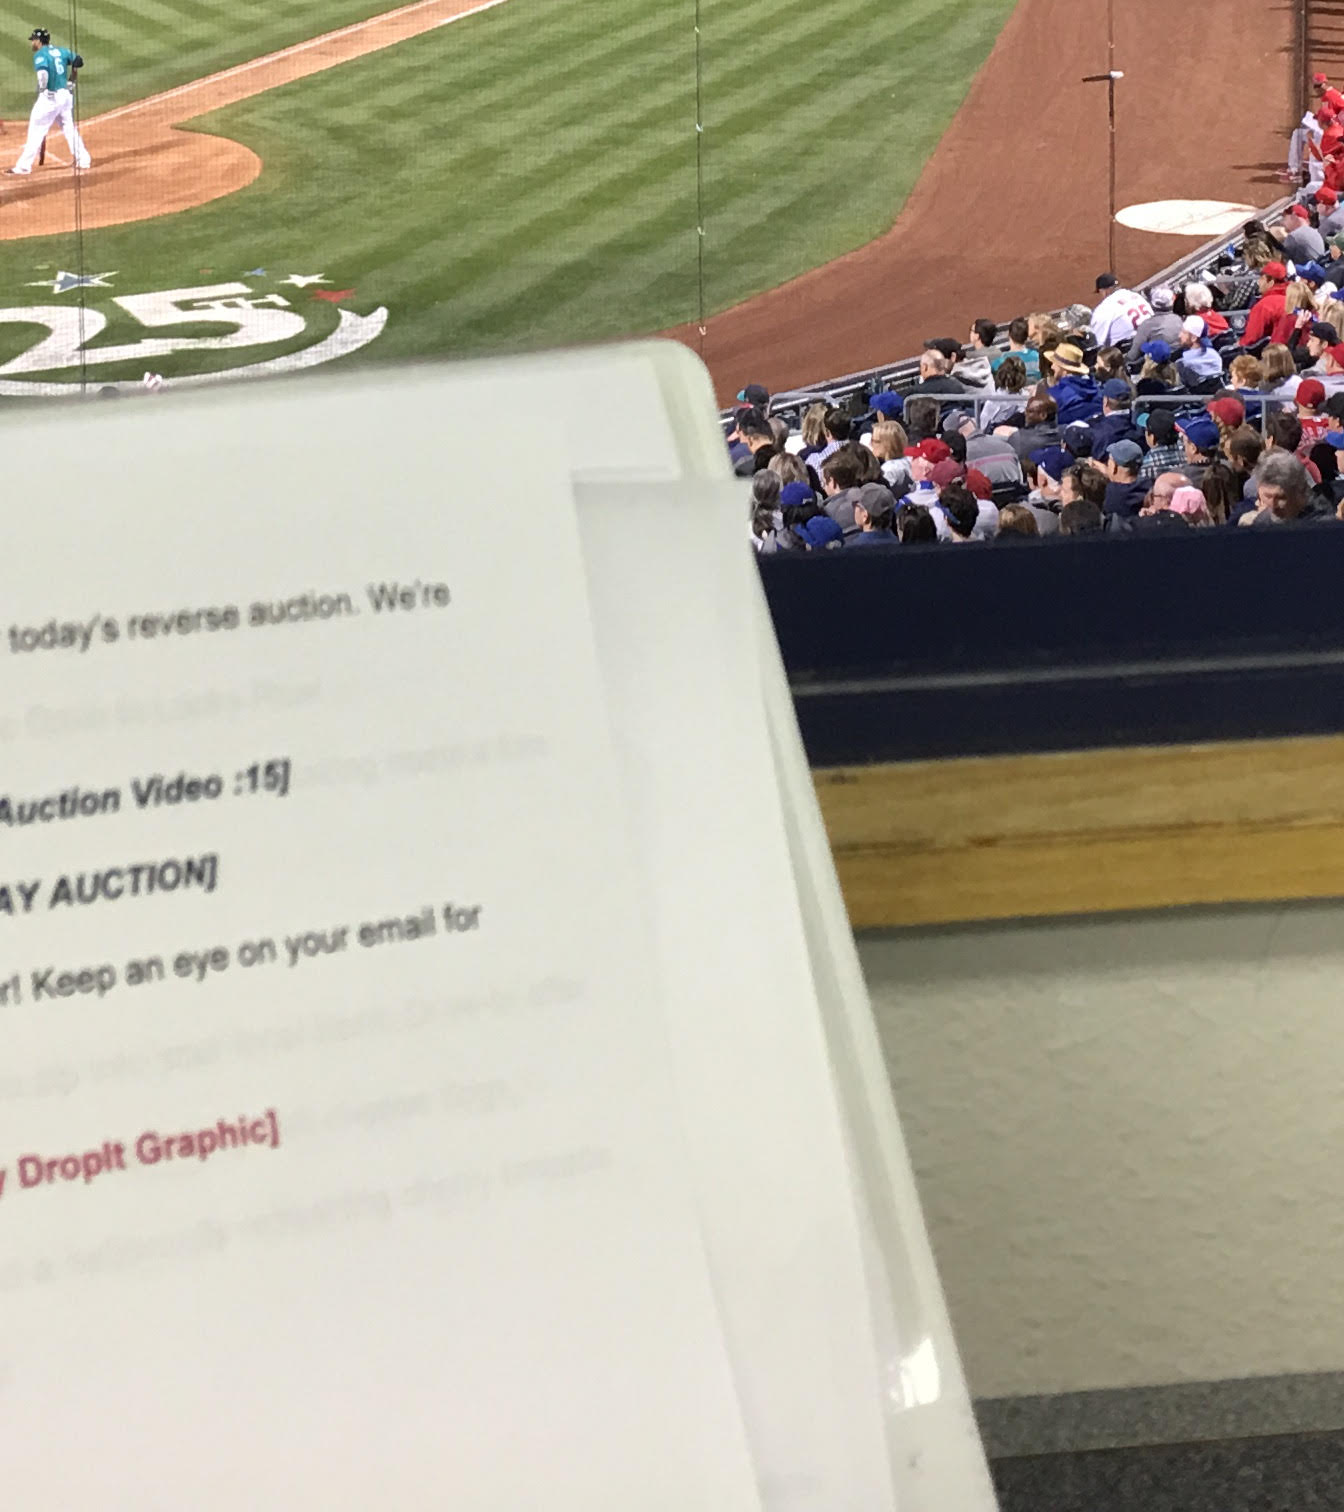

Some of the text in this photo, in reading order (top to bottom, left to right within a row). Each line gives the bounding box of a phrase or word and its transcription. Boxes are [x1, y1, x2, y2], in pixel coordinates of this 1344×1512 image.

[9, 611, 120, 653] today's
[127, 604, 240, 640] reverse
[248, 588, 360, 628] auction.
[366, 578, 451, 614] We're
[130, 769, 224, 810] Video
[233, 755, 292, 797] :15]
[49, 852, 221, 911] AUCTION]
[30, 961, 118, 1003] Keep
[124, 956, 166, 988] an
[172, 947, 232, 983] eye
[236, 938, 279, 968] on
[284, 925, 351, 967] your
[357, 904, 437, 949] email
[442, 902, 484, 934] for
[17, 1141, 126, 1190] DropIt
[135, 1107, 282, 1168] Graphic]
